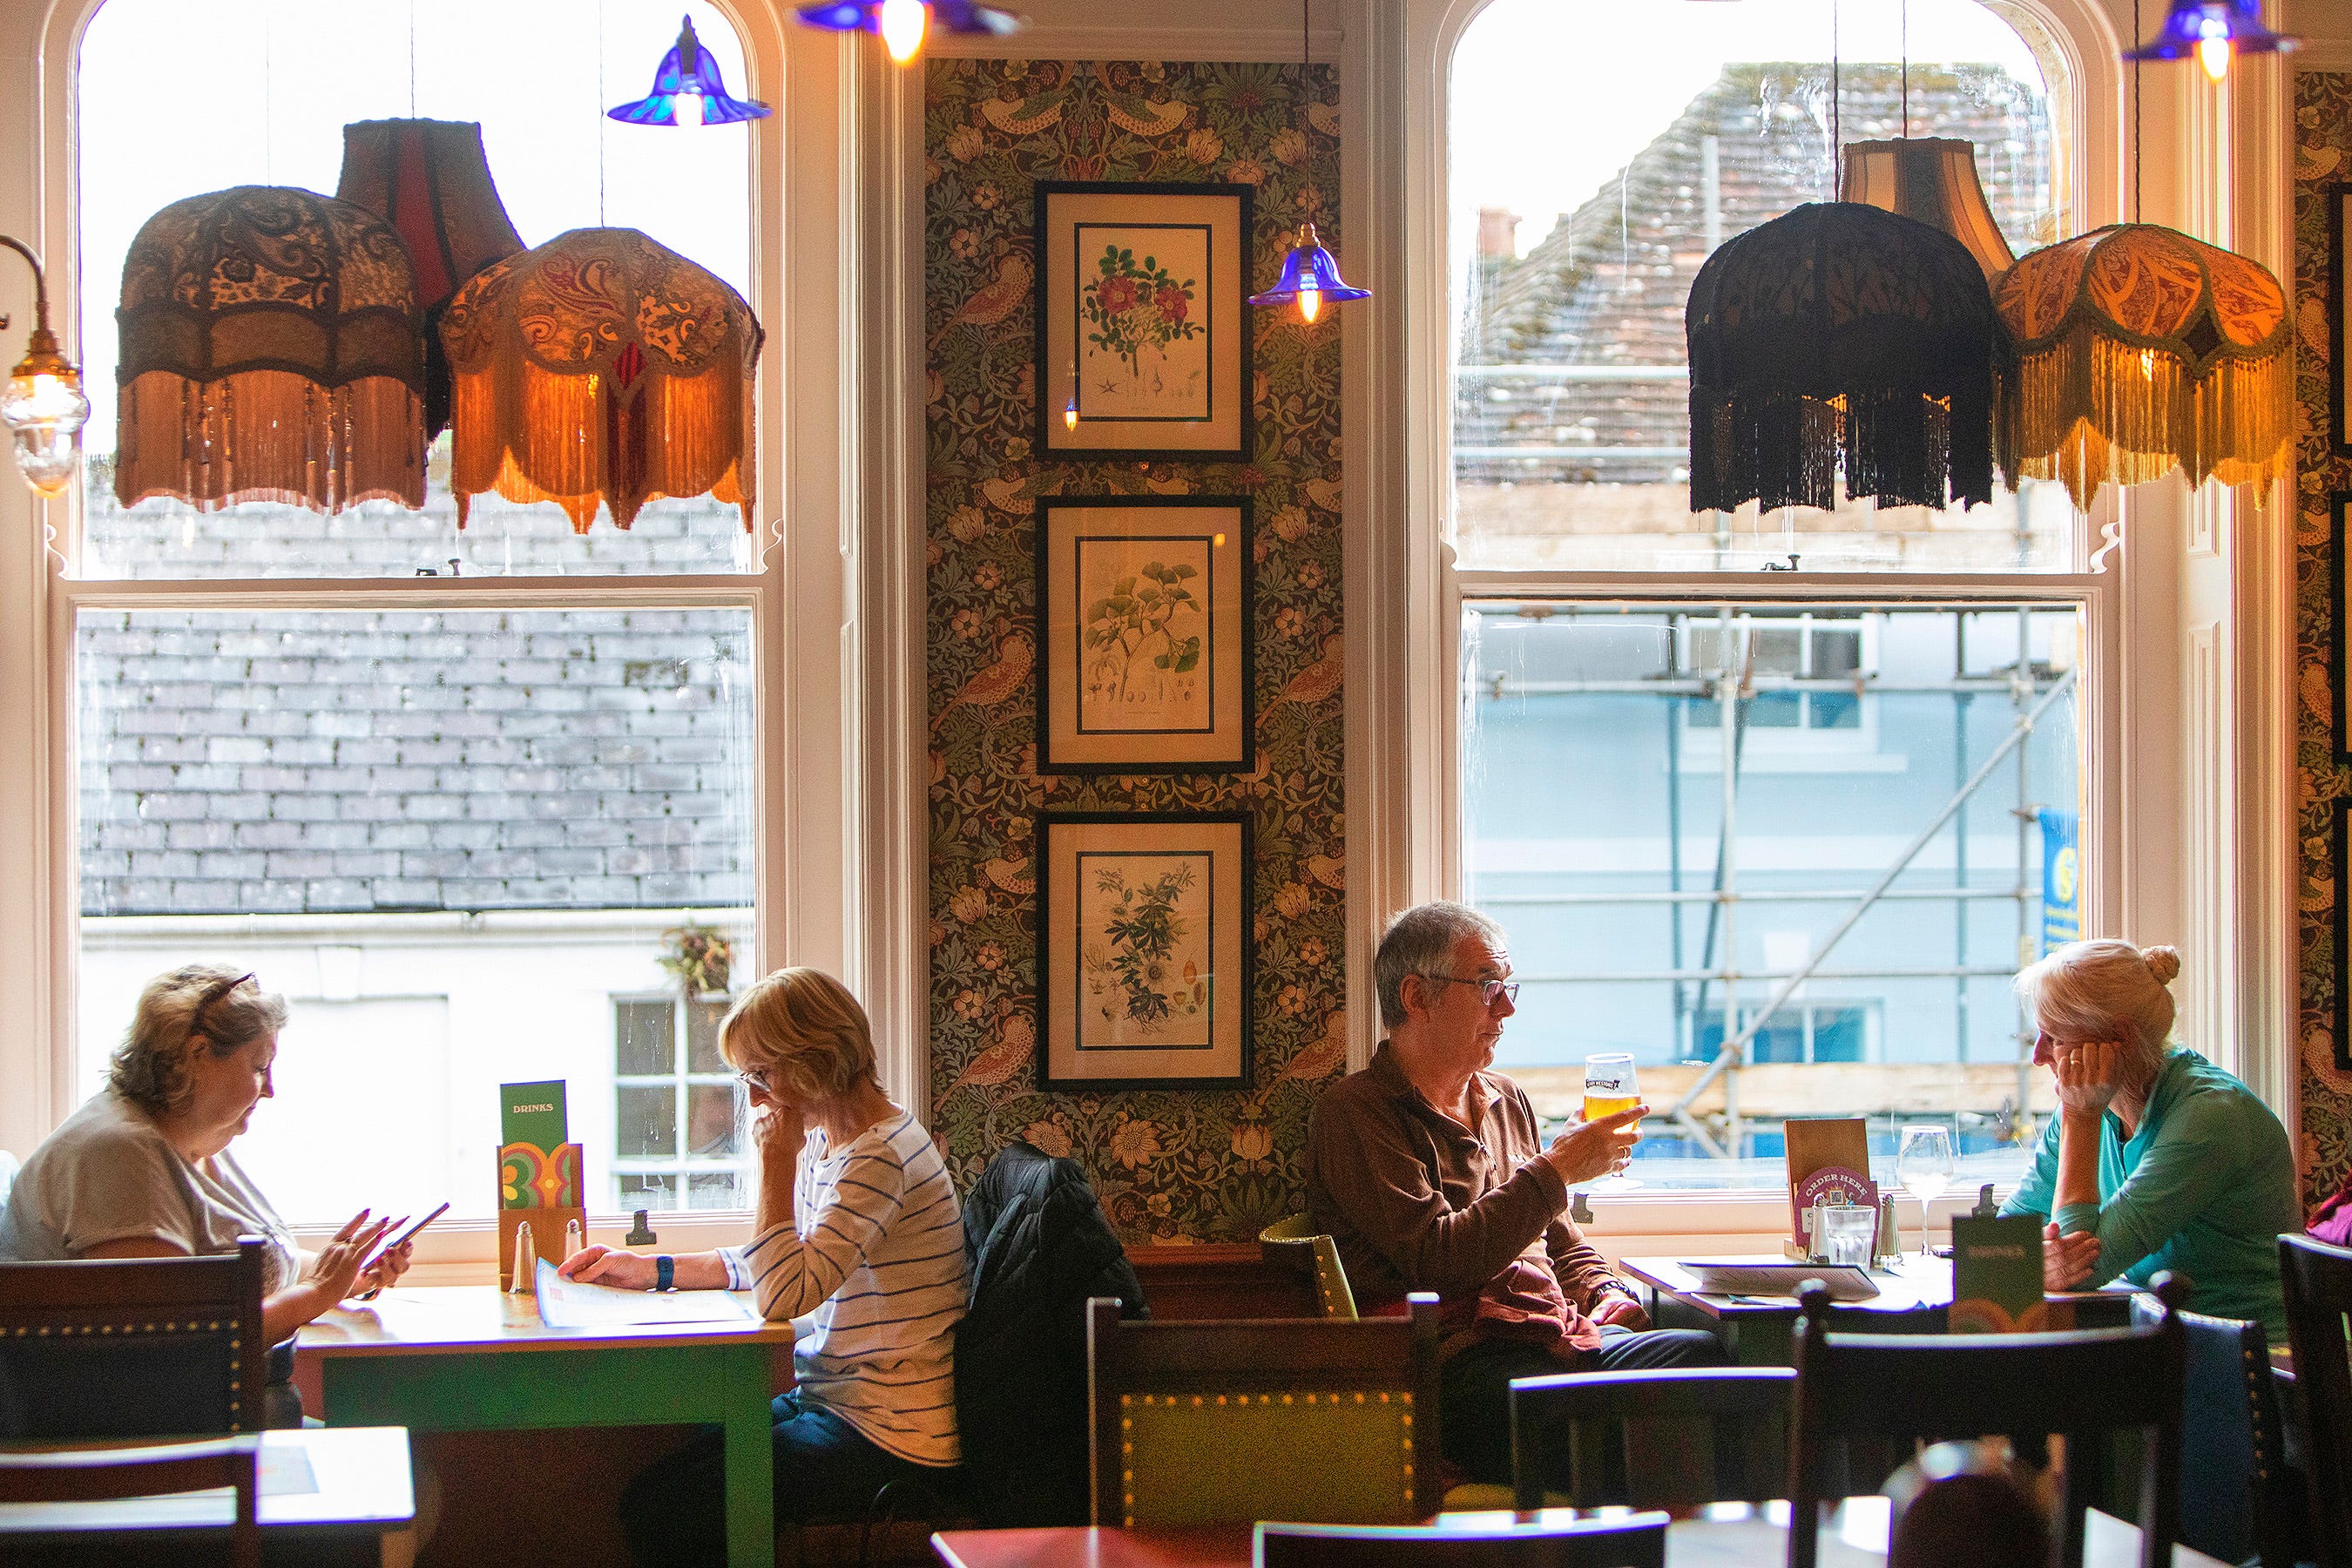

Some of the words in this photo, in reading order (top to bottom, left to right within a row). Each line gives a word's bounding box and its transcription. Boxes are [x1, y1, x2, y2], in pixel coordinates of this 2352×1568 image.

[513, 1103, 554, 1113] DRINKS
[1806, 1174, 1838, 1196] ORDER
[1840, 1175, 1868, 1196] HERE
